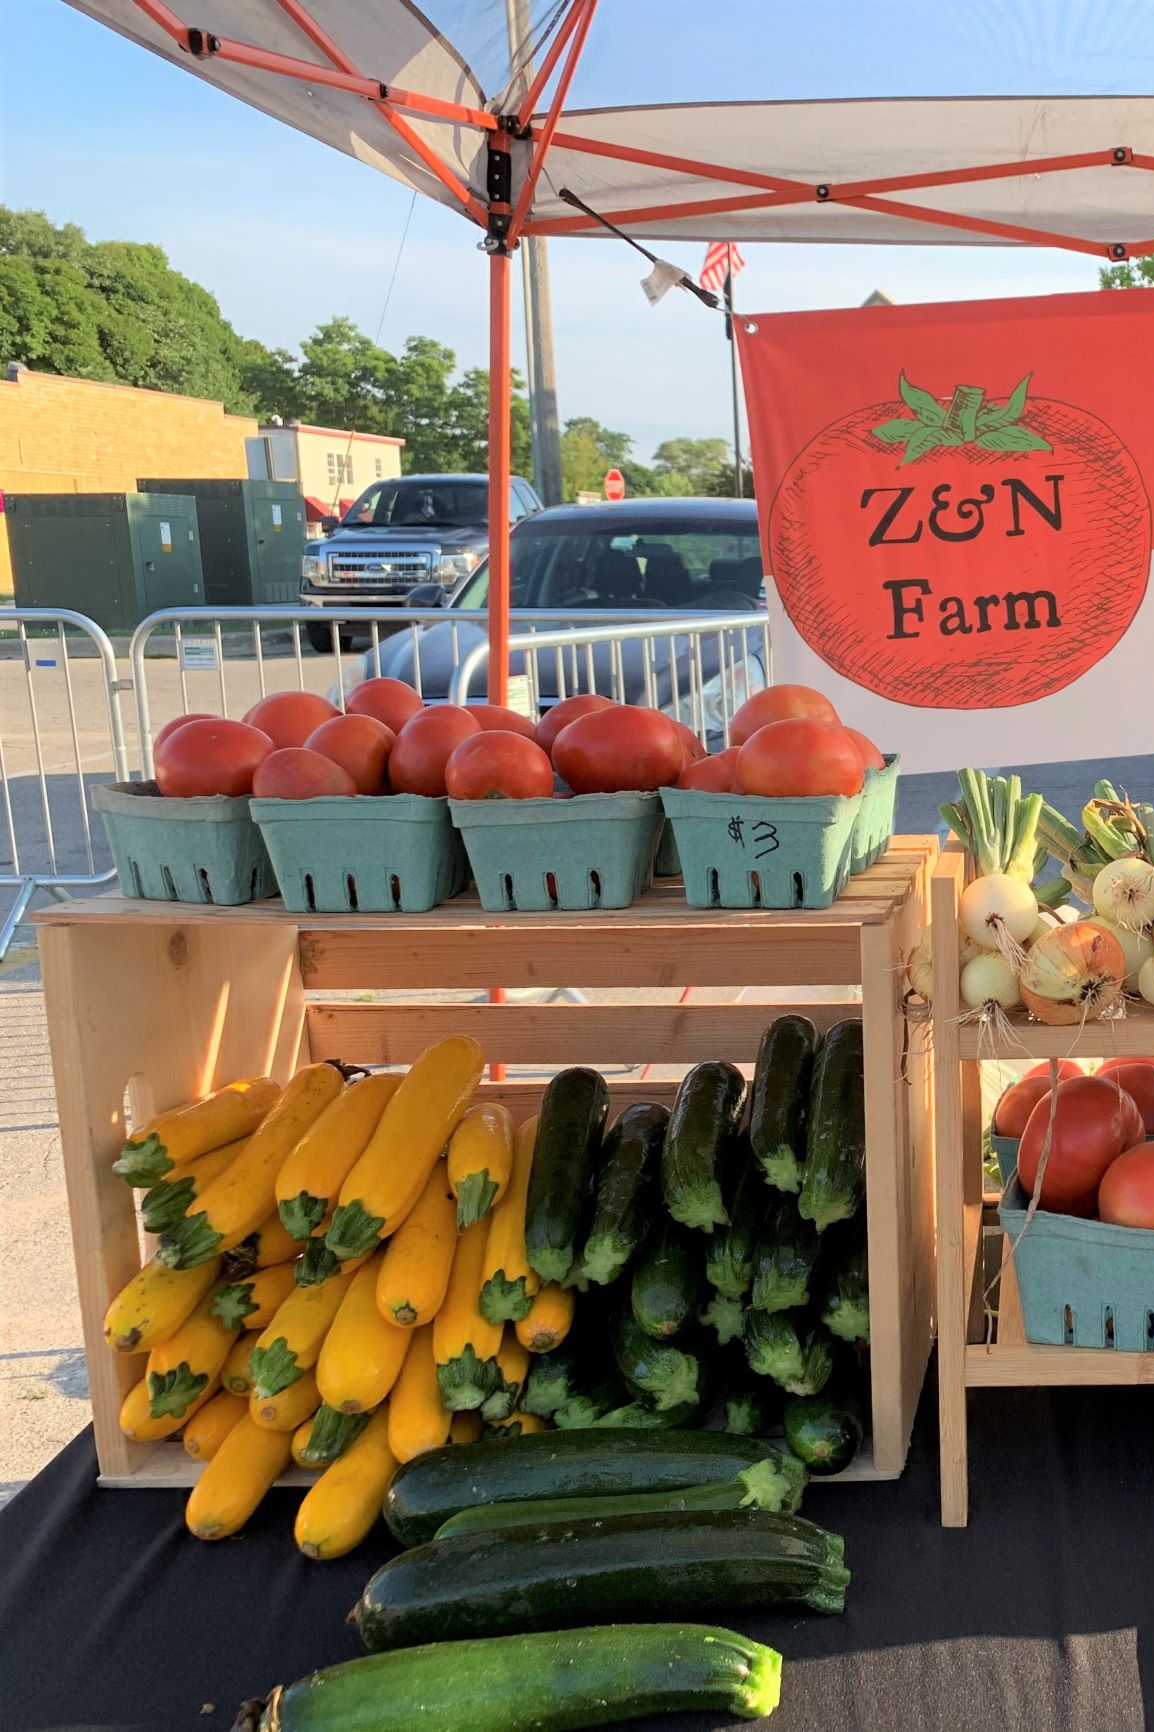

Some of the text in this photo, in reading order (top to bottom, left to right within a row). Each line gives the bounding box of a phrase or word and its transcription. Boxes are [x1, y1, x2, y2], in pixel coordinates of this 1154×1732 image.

[860, 474, 1066, 548] Z&N
[882, 578, 1063, 640] Farm
[727, 815, 780, 860] $3
